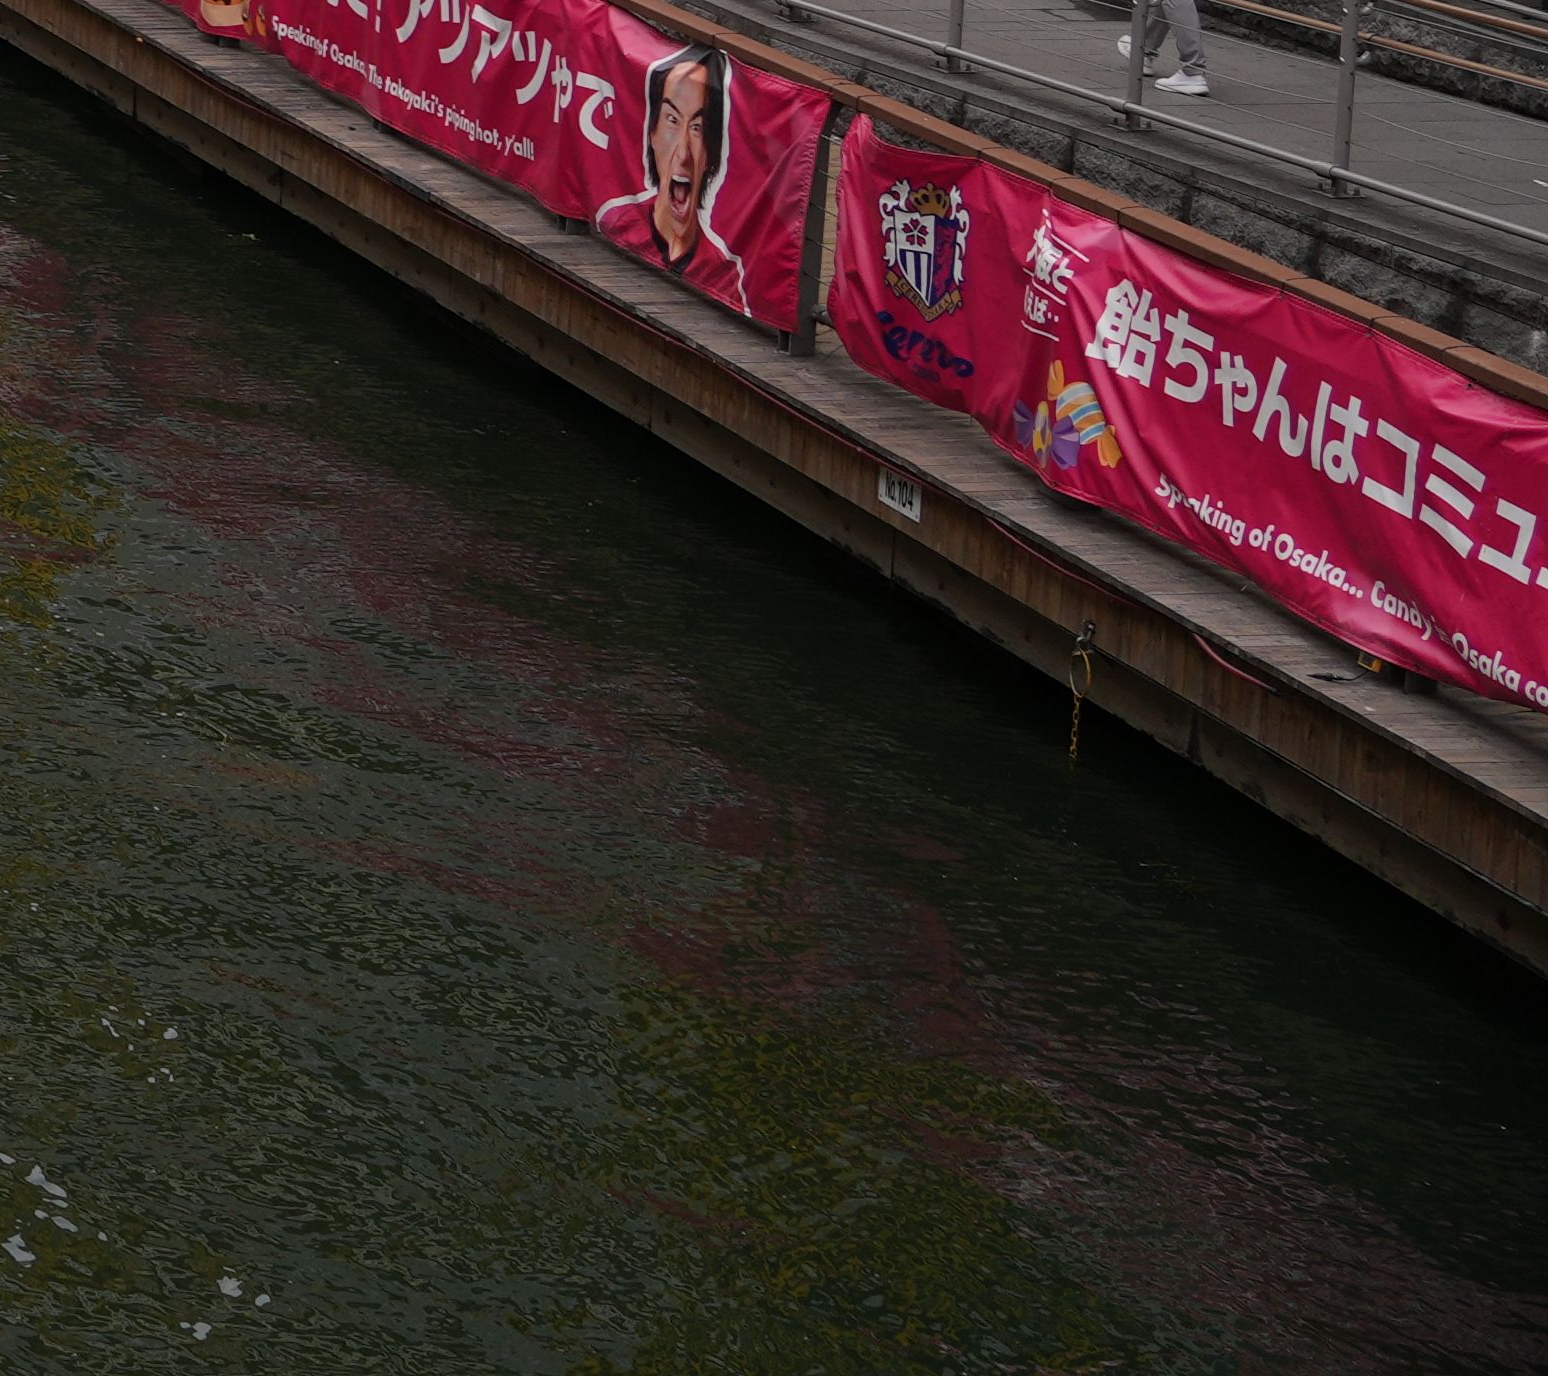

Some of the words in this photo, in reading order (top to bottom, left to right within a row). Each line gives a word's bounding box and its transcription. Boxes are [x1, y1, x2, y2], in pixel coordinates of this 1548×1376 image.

[367, 63, 383, 89] The
[384, 70, 444, 120] takoyaki's
[1249, 523, 1272, 553] of
[1450, 631, 1519, 695] Osaka
